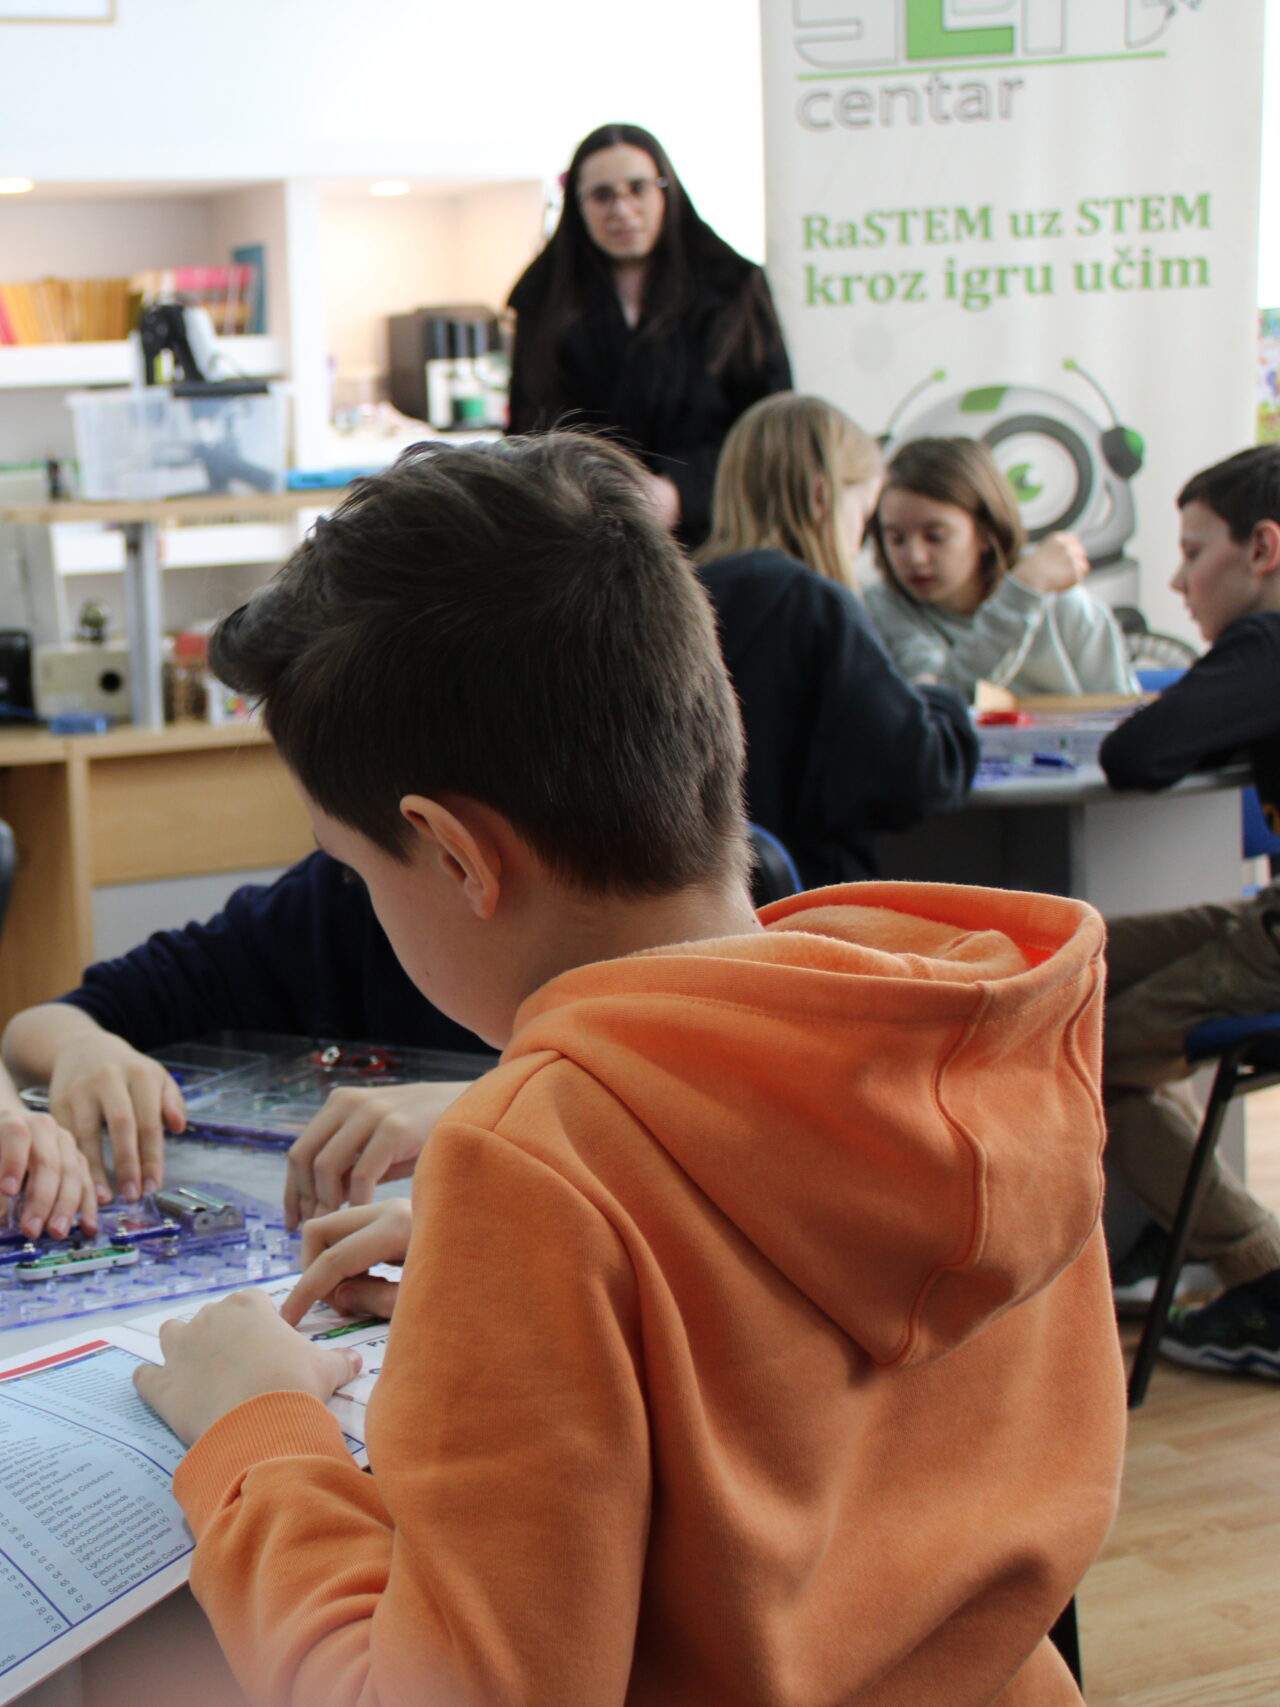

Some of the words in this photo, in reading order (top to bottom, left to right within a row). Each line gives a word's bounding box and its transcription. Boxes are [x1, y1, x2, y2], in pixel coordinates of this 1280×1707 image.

[795, 71, 1024, 132] centar
[801, 205, 993, 250] RaSTEM
[1009, 207, 1064, 239] uz
[1076, 192, 1212, 236] STEM
[802, 263, 927, 307] kroz
[944, 258, 1055, 311] igru
[1072, 246, 1211, 292] učim
[103, 1494, 129, 1511] Sounds
[111, 1502, 136, 1518] Sounds
[118, 1508, 144, 1526] Sounds
[125, 1516, 151, 1533] Sounds
[133, 1523, 159, 1540] Sounds
[92, 1557, 125, 1579] Electronic
[122, 1539, 154, 1560] Bombing
[151, 1527, 172, 1541] Game
[100, 1572, 120, 1587] Quiet
[118, 1562, 137, 1576] Zone
[135, 1549, 156, 1564] Game
[107, 1579, 130, 1596] Space
[127, 1570, 143, 1582] War
[141, 1558, 163, 1572] Music
[160, 1543, 186, 1560] Combo
